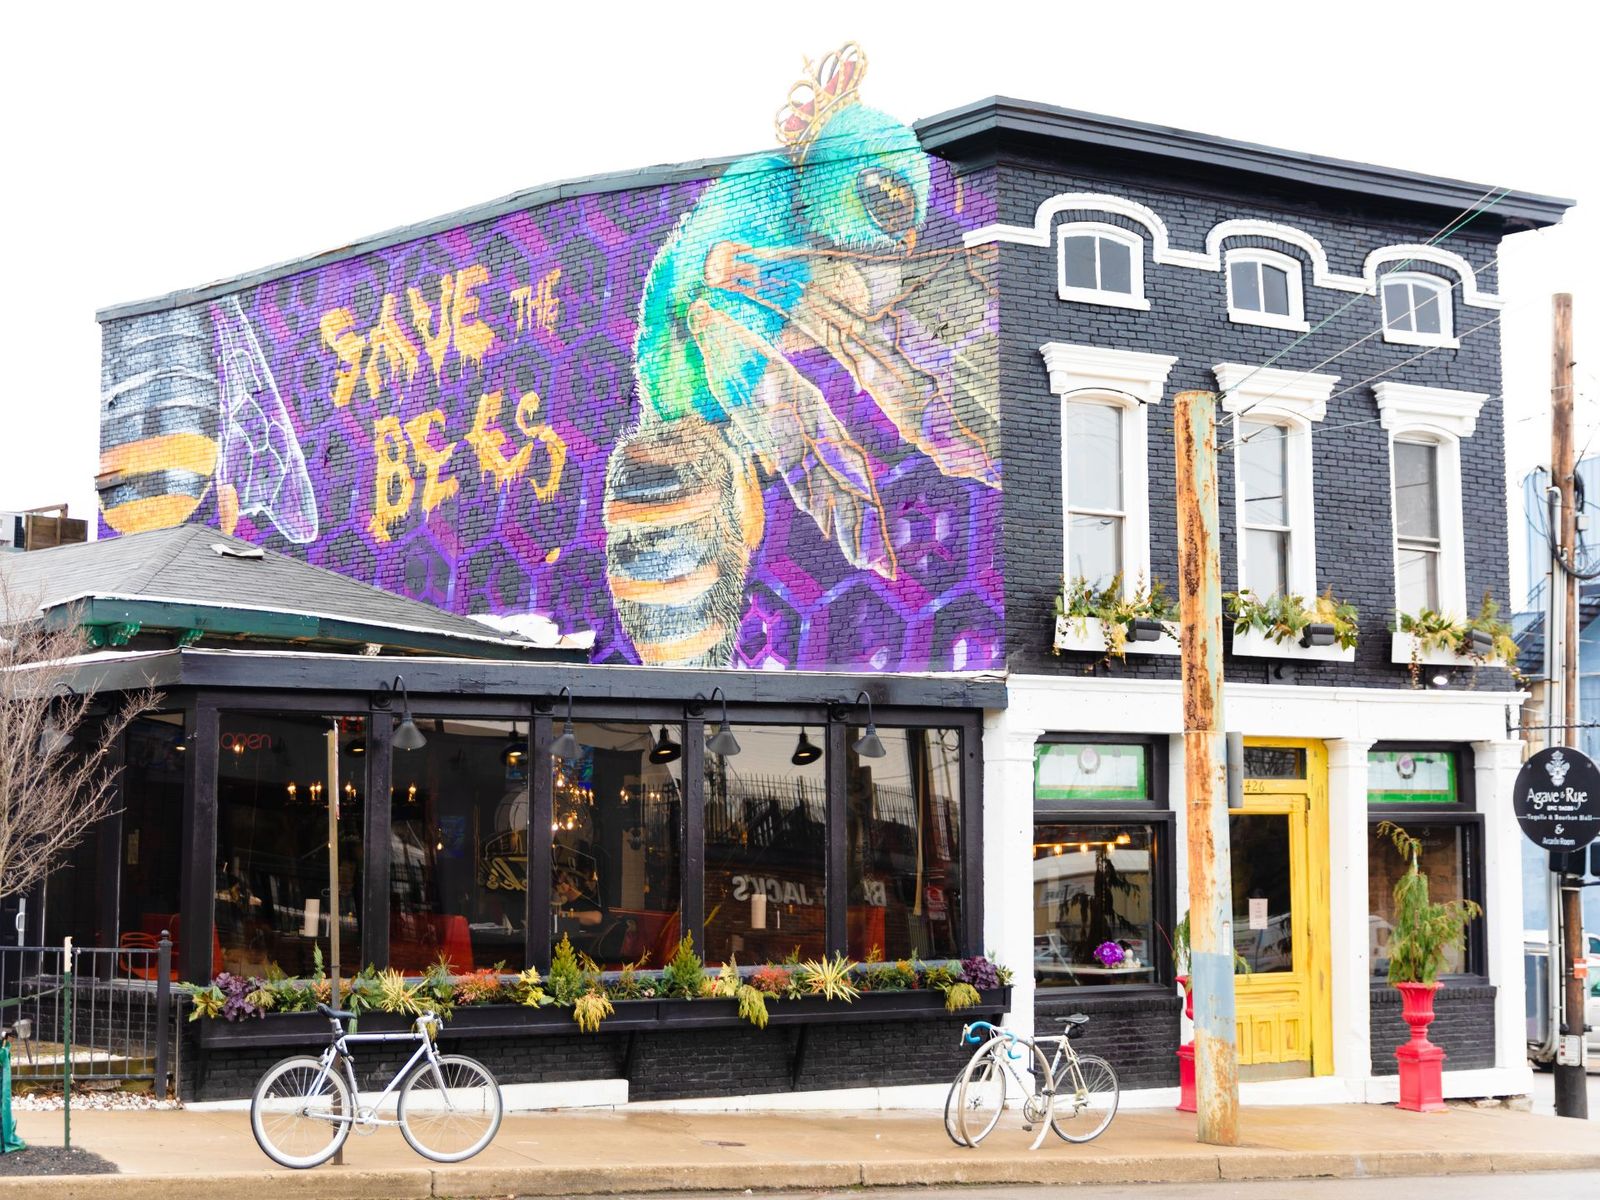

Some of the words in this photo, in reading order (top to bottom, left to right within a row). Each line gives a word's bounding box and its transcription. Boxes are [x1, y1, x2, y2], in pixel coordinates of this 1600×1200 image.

[318, 264, 496, 407] SAVE
[510, 268, 561, 336] THE
[368, 389, 567, 542] BEES
[1526, 788, 1560, 809] Agave
[1565, 787, 1588, 810] Rye
[1555, 824, 1564, 834] &
